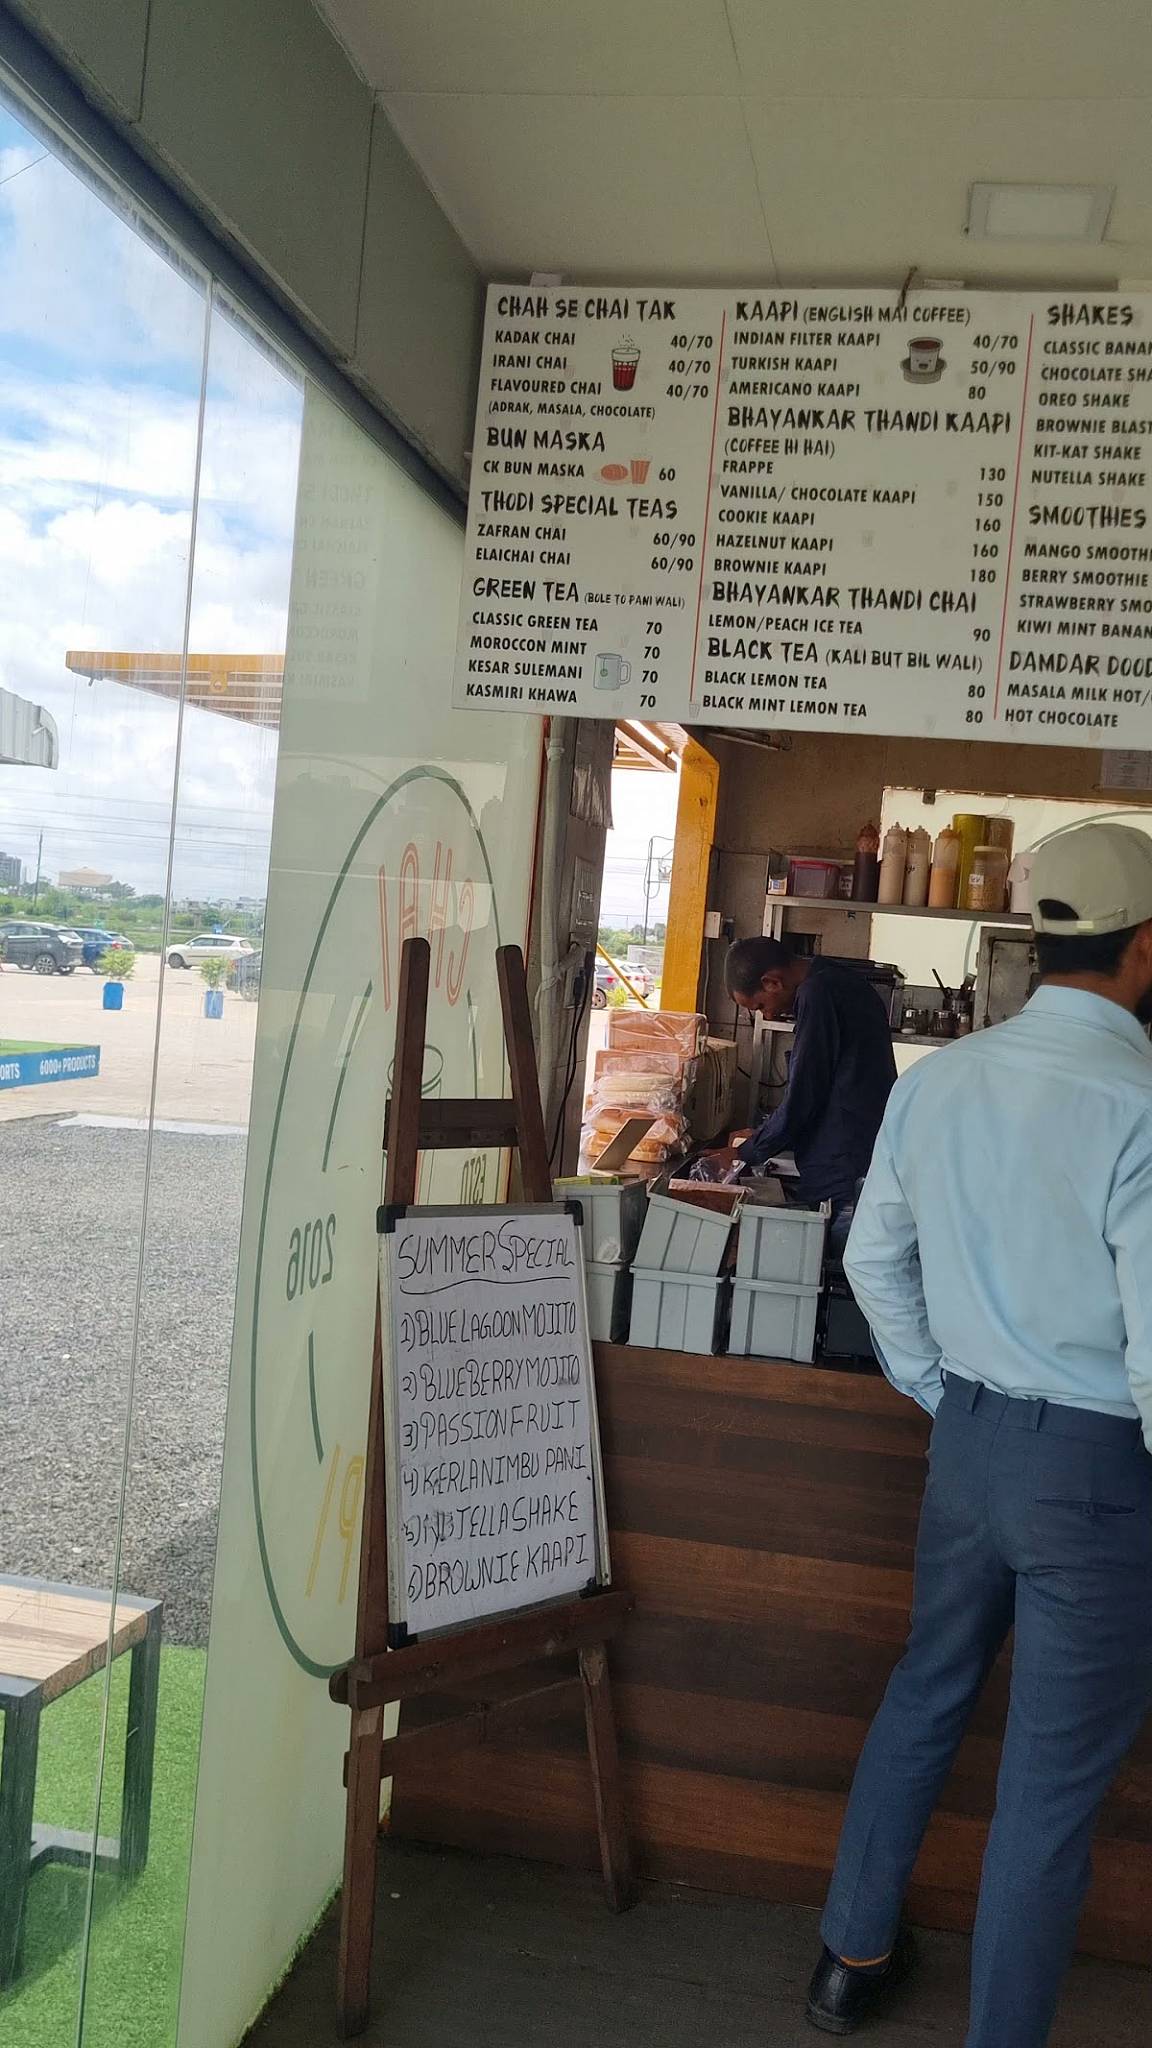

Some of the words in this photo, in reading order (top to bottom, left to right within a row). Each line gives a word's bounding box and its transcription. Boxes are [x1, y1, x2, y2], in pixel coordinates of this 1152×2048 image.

[498, 296, 549, 318] CHAH
[555, 299, 578, 318] SE
[585, 298, 629, 320] CHAI
[636, 300, 676, 322] TAK
[736, 300, 798, 322] KAAPI
[803, 305, 873, 324] (ENGLISH
[878, 306, 907, 322] MAI
[913, 306, 971, 327] COFFEE)
[1047, 303, 1134, 326] SHAKES
[495, 330, 540, 344] KADAK
[544, 331, 575, 345] CHAI
[670, 335, 713, 351] 40/70
[734, 331, 785, 345] INDIAN
[790, 332, 832, 346] FILTER
[837, 332, 880, 346] KAAPI
[973, 334, 1018, 352] 40/70
[1043, 341, 1100, 355] CLASSIC
[493, 354, 531, 368] IRANI
[536, 356, 567, 370] CHAI
[668, 360, 711, 376] 40/70
[731, 356, 790, 371] TURKISH
[795, 357, 837, 371] KAAPI
[970, 360, 1016, 377] 50/90
[1041, 367, 1122, 381] CHOCOLATE
[491, 378, 566, 393] FLAVOURED
[570, 381, 602, 395] CHAI
[666, 384, 709, 401] 40/70
[729, 381, 812, 396] AMERICANO
[817, 383, 860, 397] KAAPI
[968, 386, 986, 400] 80
[1038, 392, 1077, 407] OREO
[1083, 393, 1130, 408] SHAKE
[489, 401, 533, 415] (ADRAK,
[537, 403, 586, 417] MASALA,
[590, 405, 655, 421] CHOCOLATE)
[728, 406, 855, 431] BHAYANKAR
[864, 409, 938, 433] THANDI
[946, 411, 1011, 434] KAAPI
[1036, 418, 1106, 433] BROWNIE
[487, 427, 527, 449] BUN
[534, 430, 605, 452] MASKA
[724, 438, 779, 456] (COFFEE
[784, 438, 798, 455] HI
[803, 439, 835, 459] HAI)
[1034, 444, 1089, 459] KIT-KAT
[1094, 445, 1141, 460] SHAKE
[483, 460, 500, 473] CK
[504, 461, 532, 475] BUN
[537, 463, 585, 478] MASKA
[659, 467, 676, 481] 60
[723, 460, 774, 474] FRAPPE
[980, 467, 1006, 481] 130
[1031, 470, 1092, 485] NUTELLA
[1098, 472, 1146, 486] SHAKE
[481, 490, 534, 512] THODI
[541, 494, 618, 517] SPECIAL
[626, 498, 677, 520] TEAS
[791, 487, 868, 502] CHOCOLATE
[873, 489, 916, 504] KAAPI
[978, 493, 1003, 507] 150
[718, 509, 768, 524] COOKIE
[773, 511, 815, 526] KAAPI
[976, 518, 1001, 532] 160
[1029, 505, 1147, 529] SMOOTHIES
[477, 523, 530, 539] ZAFRAN
[535, 527, 566, 541] CHAI
[653, 532, 696, 549] 60/90
[716, 534, 787, 549] HAZELNUT
[791, 537, 833, 552] KAAPI
[973, 543, 999, 558] 160
[476, 547, 534, 563] ELAICHAI
[539, 551, 571, 565] CHAI
[651, 556, 693, 574] 60/90
[1024, 543, 1081, 559] MANGO
[714, 558, 779, 574] BROWNIE
[784, 561, 826, 576] KAAPI
[971, 569, 996, 583] 180
[1022, 569, 1068, 583] BERRY
[1073, 571, 1149, 587] SMOOTHIE
[473, 577, 536, 601] GREEN
[542, 581, 579, 603] TEA
[614, 594, 626, 605] TO
[628, 595, 653, 606] PANI
[655, 596, 685, 610] WALI)
[712, 581, 840, 608] BHAYANKAR
[848, 587, 922, 610] THANDI
[929, 590, 976, 613] CHAI
[1019, 594, 1115, 611] STRAWBERRY
[472, 611, 523, 627] CLASSIC
[527, 615, 570, 630] GREEN
[575, 617, 598, 631] TEA
[646, 621, 663, 635] 70
[814, 619, 834, 633] ICE
[839, 620, 863, 635] TEA
[973, 628, 991, 642] 90
[1017, 619, 1052, 634] KIWI
[1057, 621, 1097, 636] MINT
[470, 635, 546, 653] MOROCCON
[551, 640, 587, 655] MINT
[644, 646, 660, 659] 70
[708, 637, 772, 660] BLACK
[780, 642, 818, 664] TEA
[826, 649, 866, 666] (KALI
[871, 650, 903, 668] BUT
[907, 652, 930, 668] BIL
[936, 654, 983, 674] WALI)
[468, 659, 510, 674] KESAR
[514, 662, 582, 679] SULEMANI
[642, 670, 658, 684] 70
[1009, 651, 1100, 675] DAMDAR
[466, 683, 523, 699] KASMIRI
[528, 688, 577, 703] KHAWA
[640, 694, 656, 708] 70
[704, 670, 746, 685] BLACK
[751, 673, 798, 688] LEMON
[803, 676, 827, 690] TEA
[968, 684, 985, 698] 80
[1007, 683, 1066, 699] MASALA
[1071, 686, 1108, 701] MILK
[703, 695, 744, 710] BLACK
[748, 698, 786, 712] MINT
[790, 700, 838, 715] LEMON
[843, 703, 867, 717] TEA
[965, 710, 983, 724] 80
[1005, 708, 1033, 723] HOT
[1038, 710, 1118, 728] CHOCOLATE
[62, 1054, 96, 1073] PRODUCTS
